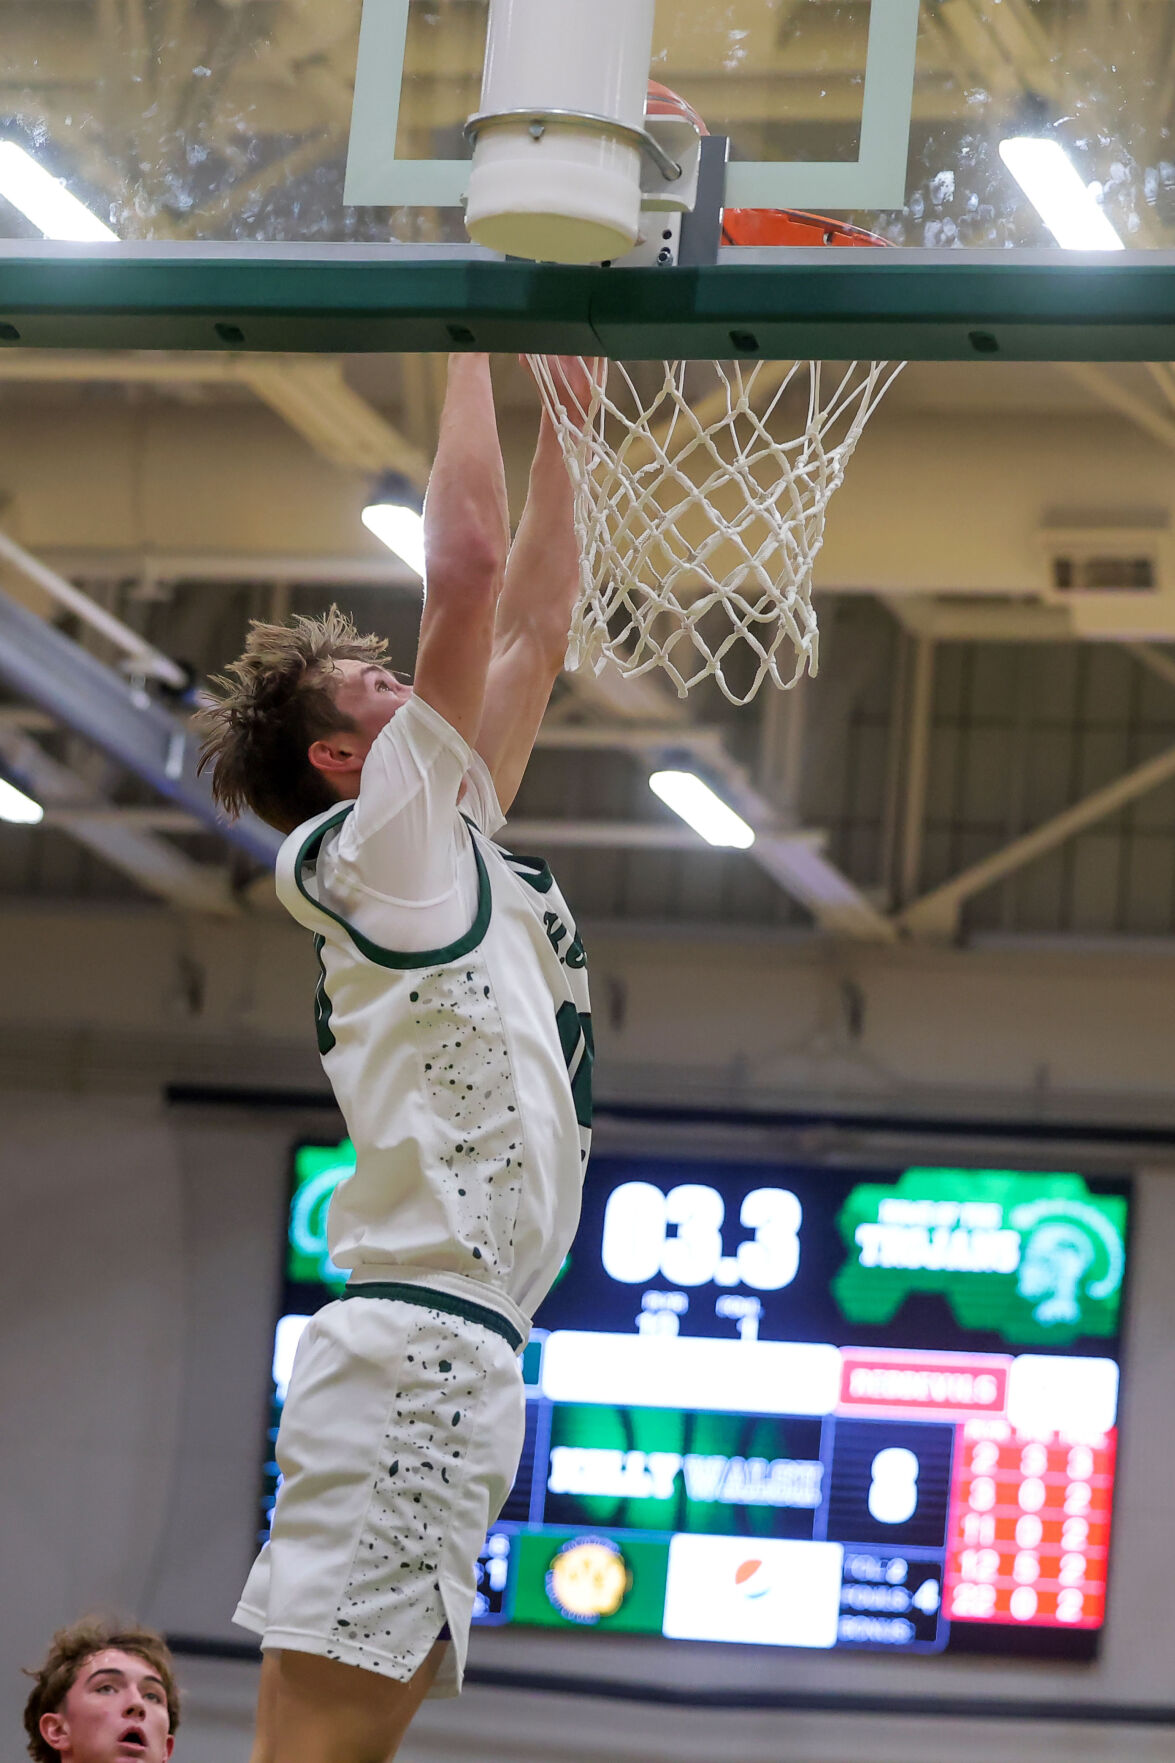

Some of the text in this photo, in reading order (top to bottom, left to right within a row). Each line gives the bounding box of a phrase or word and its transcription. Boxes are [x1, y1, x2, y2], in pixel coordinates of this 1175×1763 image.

[602, 1181, 803, 1291] 03.3
[868, 1447, 919, 1524] 8
[912, 1578, 941, 1616] 4
